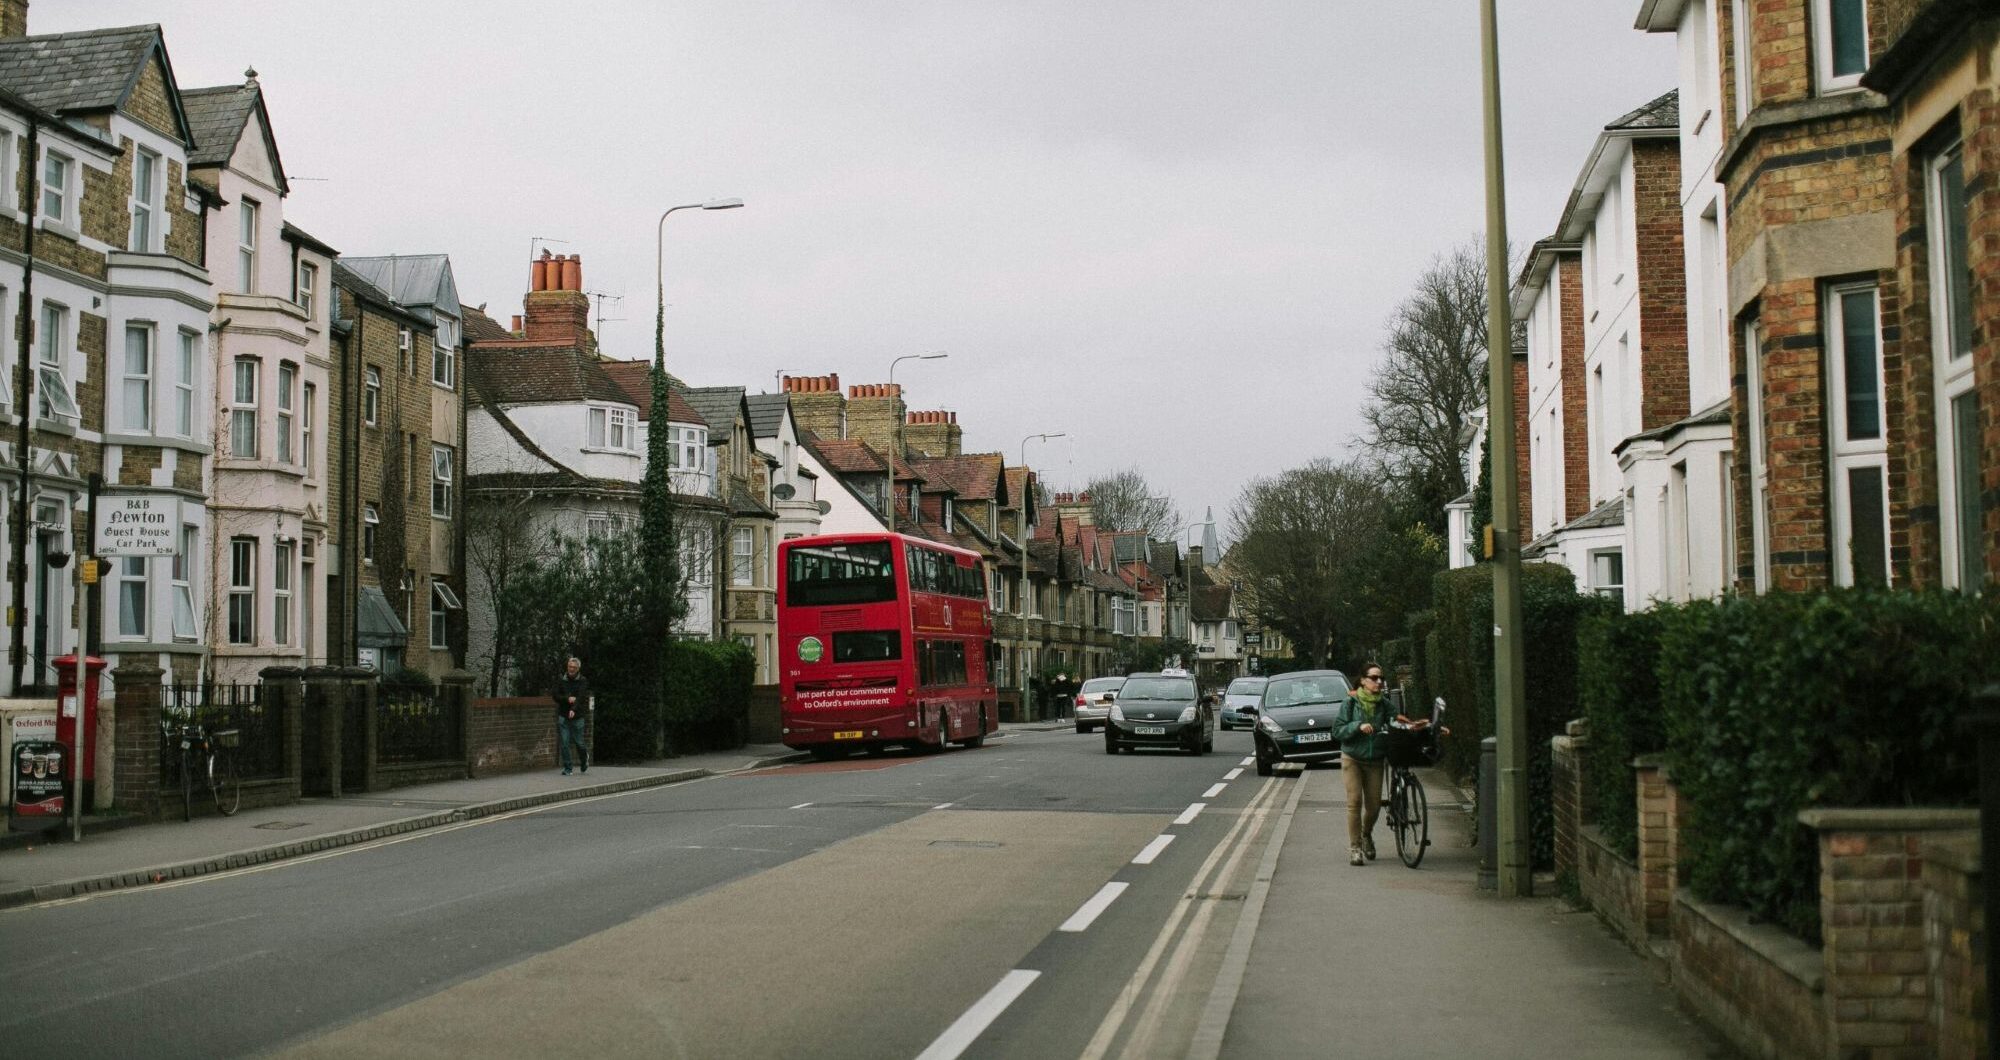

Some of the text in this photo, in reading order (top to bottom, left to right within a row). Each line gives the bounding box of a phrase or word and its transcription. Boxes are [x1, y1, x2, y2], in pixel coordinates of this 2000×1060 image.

[127, 500, 150, 509] B&B
[108, 511, 165, 523] Newton
[104, 527, 170, 537] Guest House
[811, 690, 826, 699] part
[827, 688, 835, 697] of
[849, 687, 896, 696] commitment
[813, 700, 842, 708] Oxford's
[843, 698, 889, 706] environment
